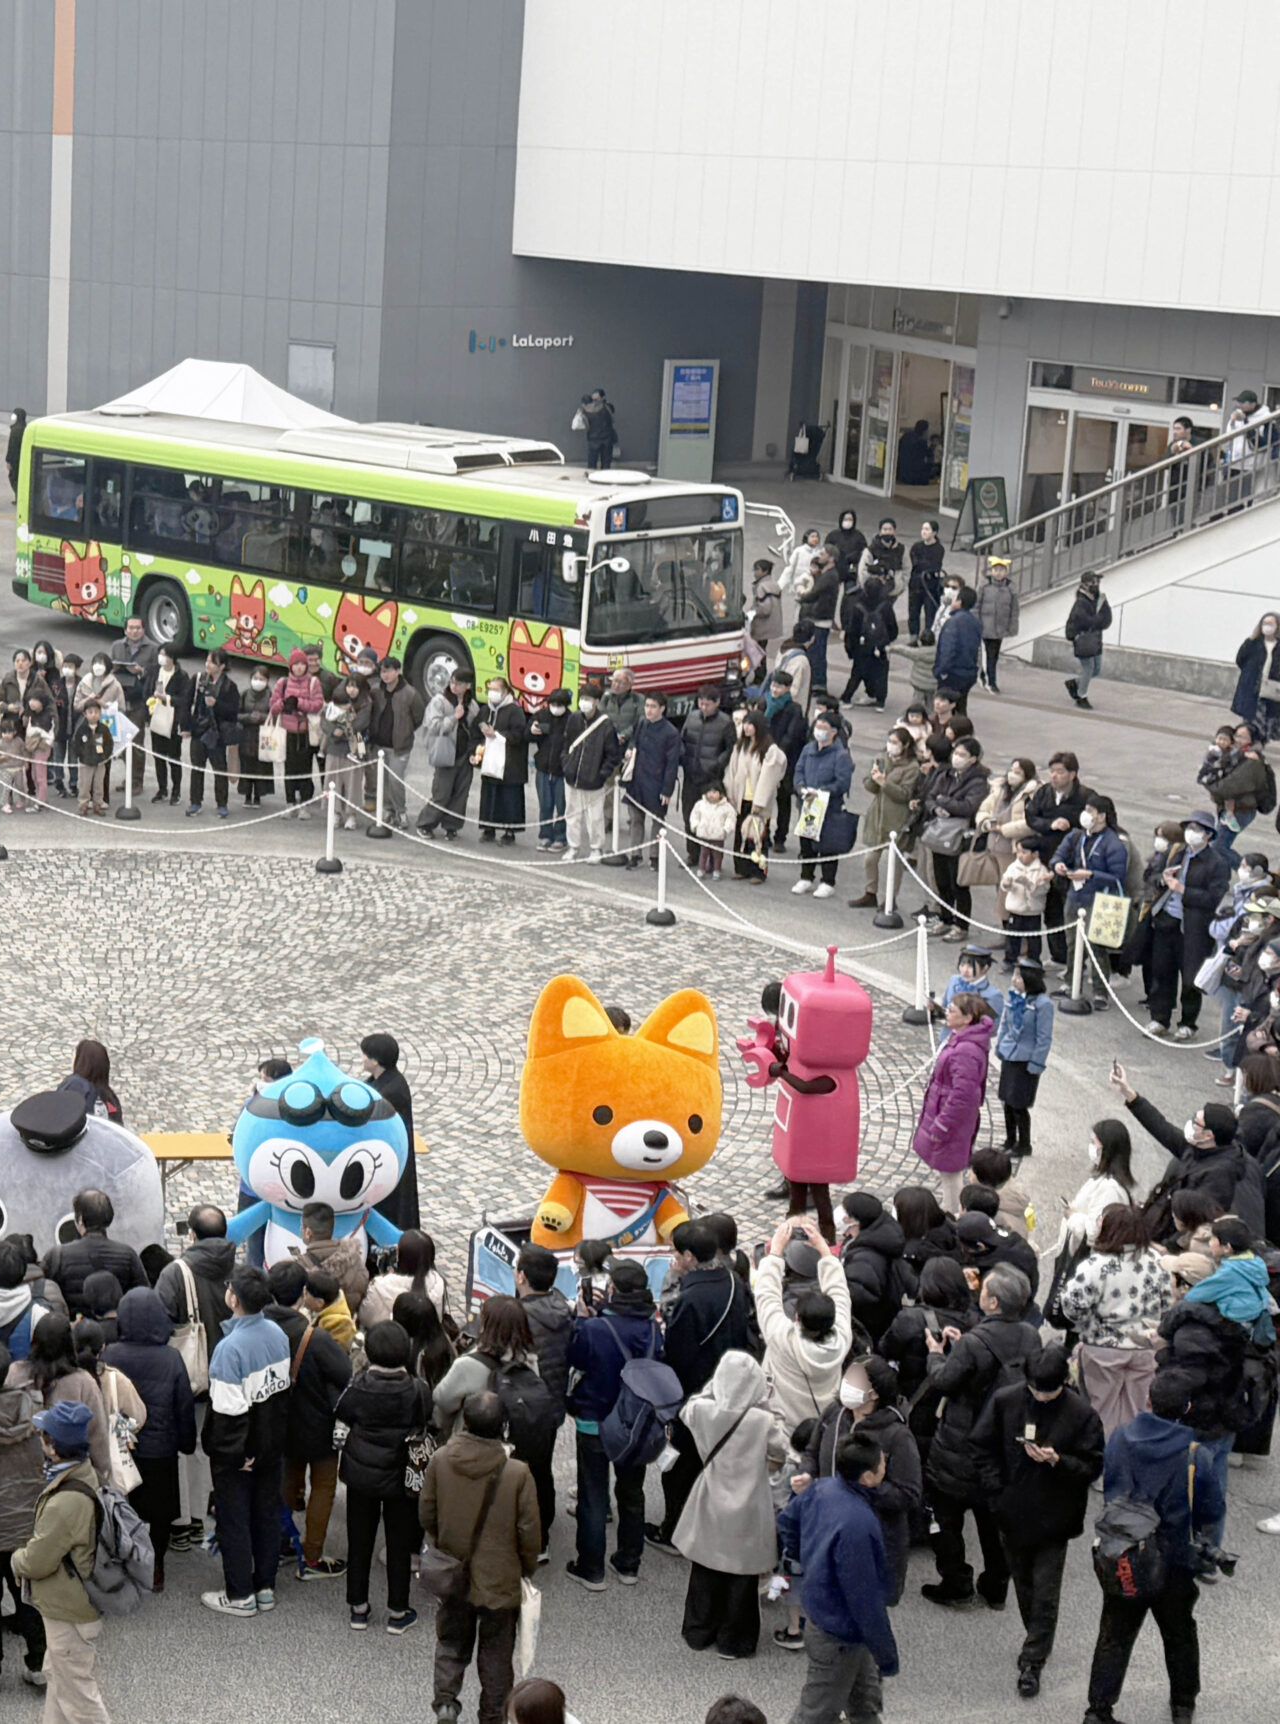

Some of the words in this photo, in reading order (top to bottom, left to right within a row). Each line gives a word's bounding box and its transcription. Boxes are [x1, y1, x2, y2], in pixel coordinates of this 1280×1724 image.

[512, 334, 574, 350] LaLaport
[528, 528, 574, 549] 小田急
